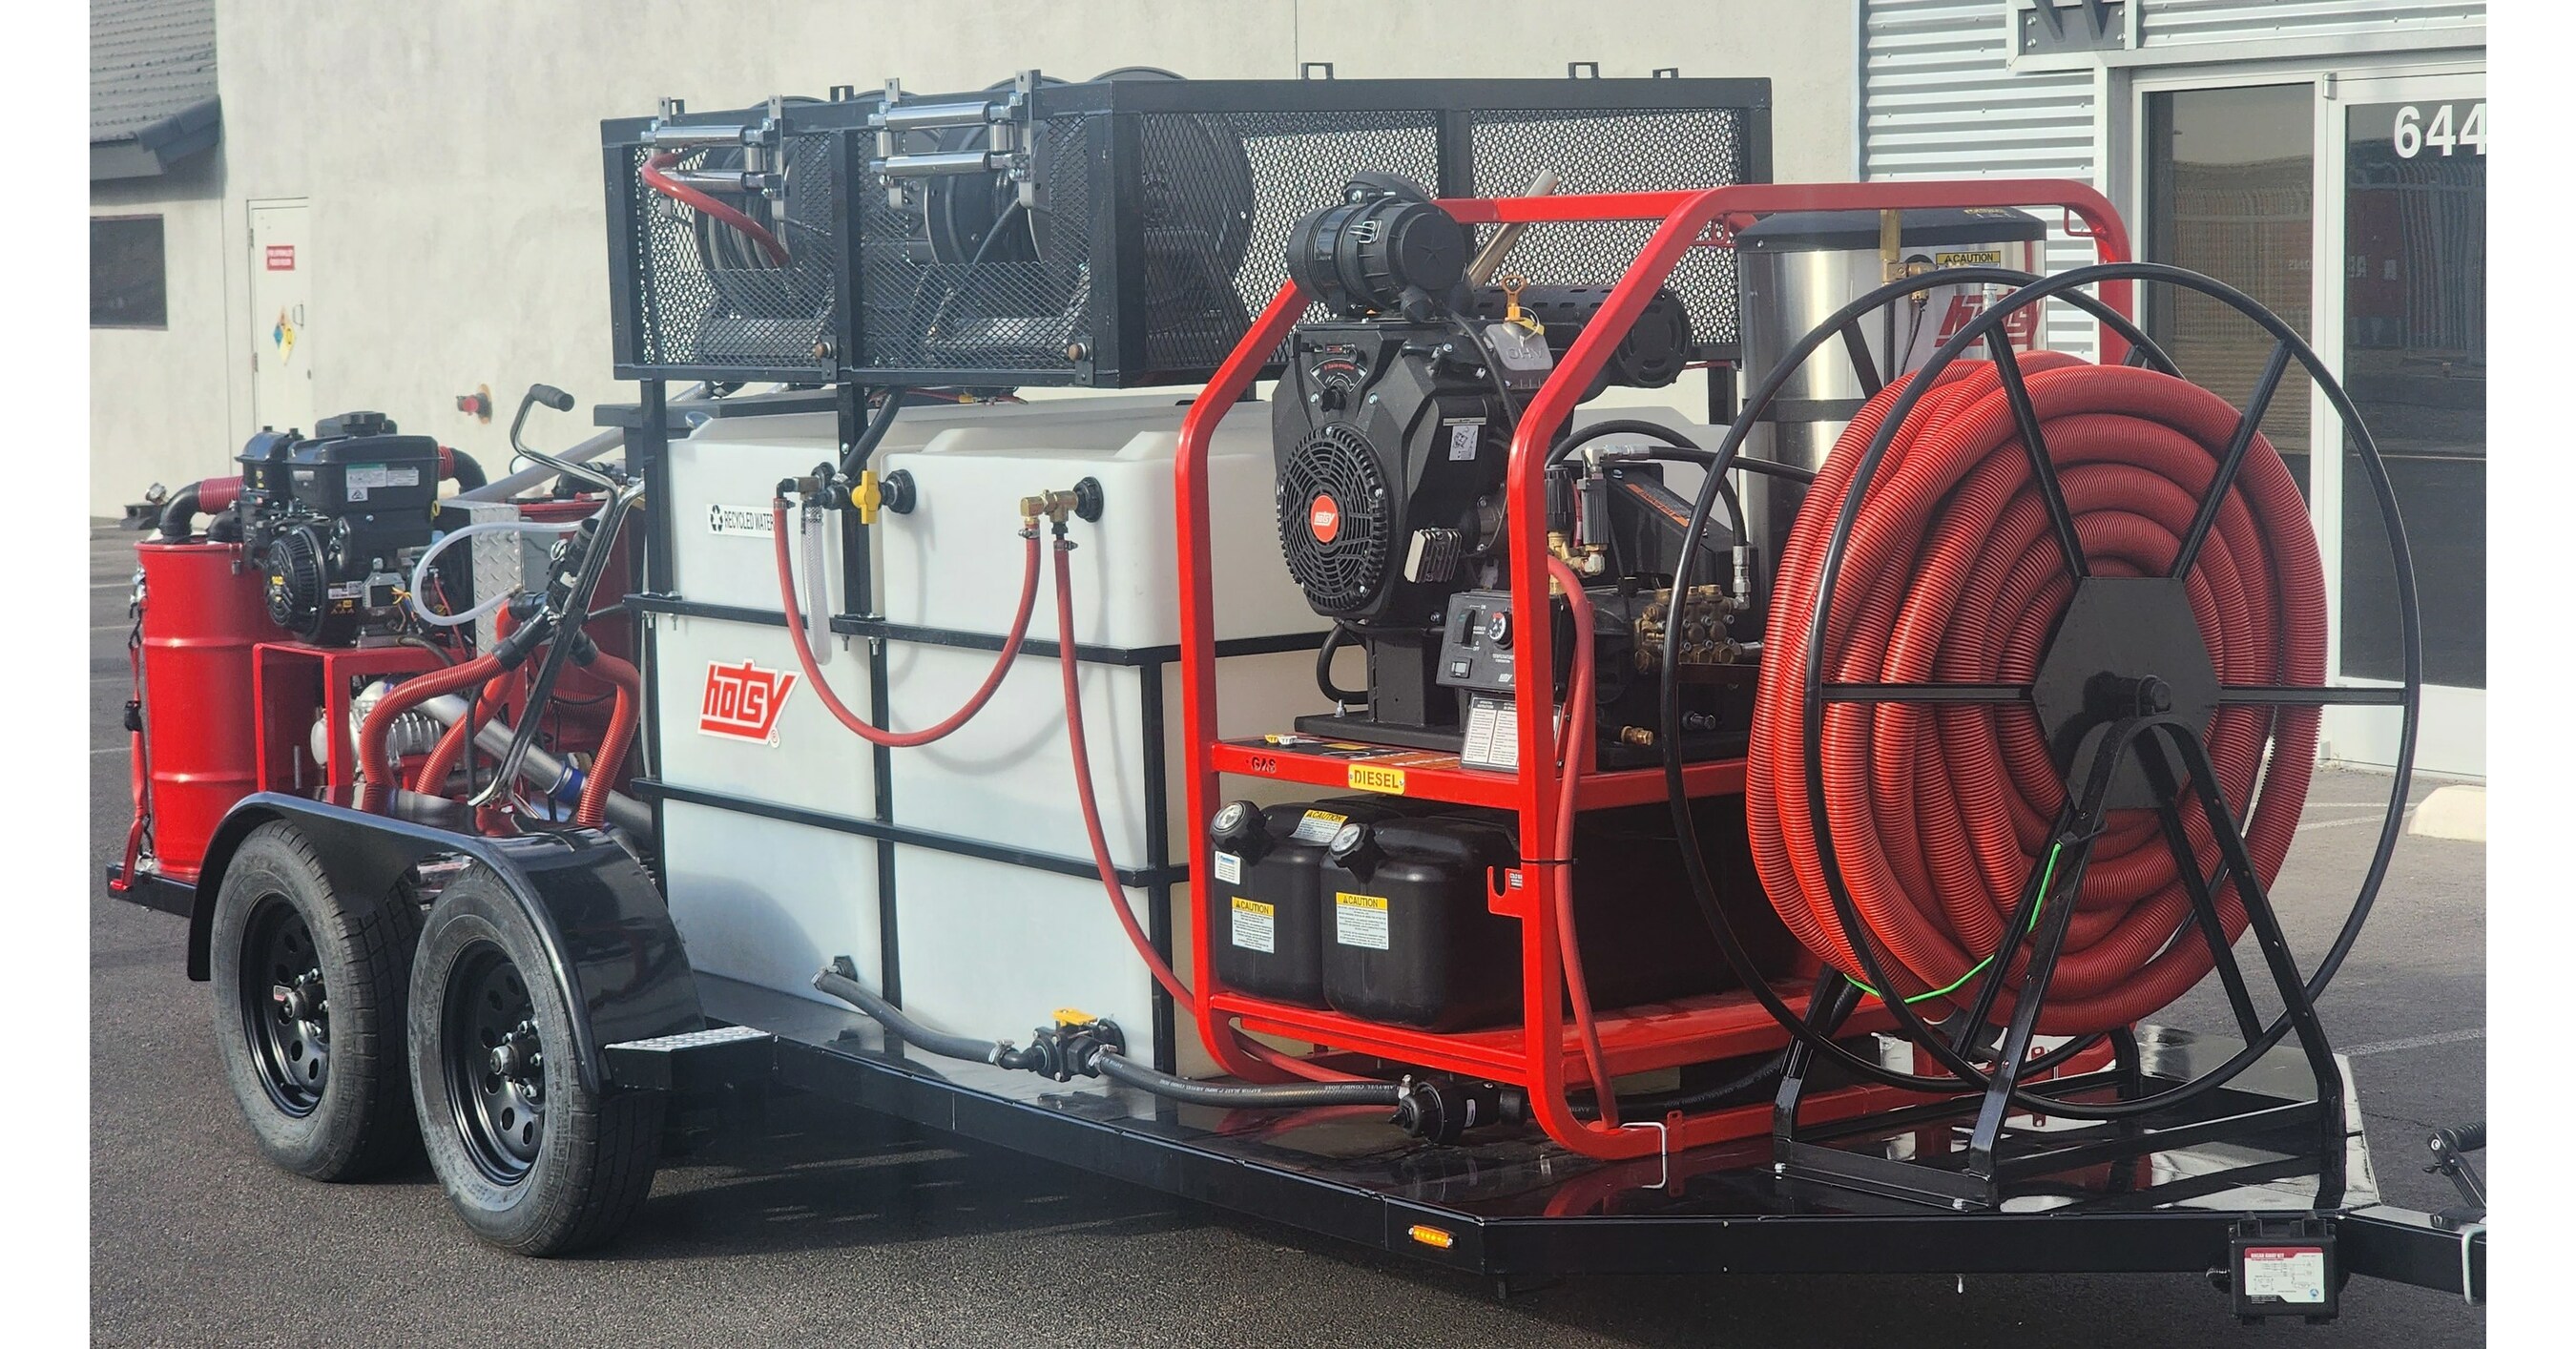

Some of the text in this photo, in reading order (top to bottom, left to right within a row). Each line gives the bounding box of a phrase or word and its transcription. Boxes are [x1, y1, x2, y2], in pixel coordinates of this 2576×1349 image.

[2394, 103, 2486, 159] 644
[1952, 253, 1994, 263] CAUTION
[724, 510, 754, 529] RECYCLED
[700, 662, 796, 740] hotsy
[1251, 756, 1277, 773] GAS
[1354, 769, 1400, 789] DIESEL
[1312, 811, 1343, 821] CAUTION
[1240, 901, 1269, 914] CAUTION
[1347, 896, 1379, 907] CAUTION
